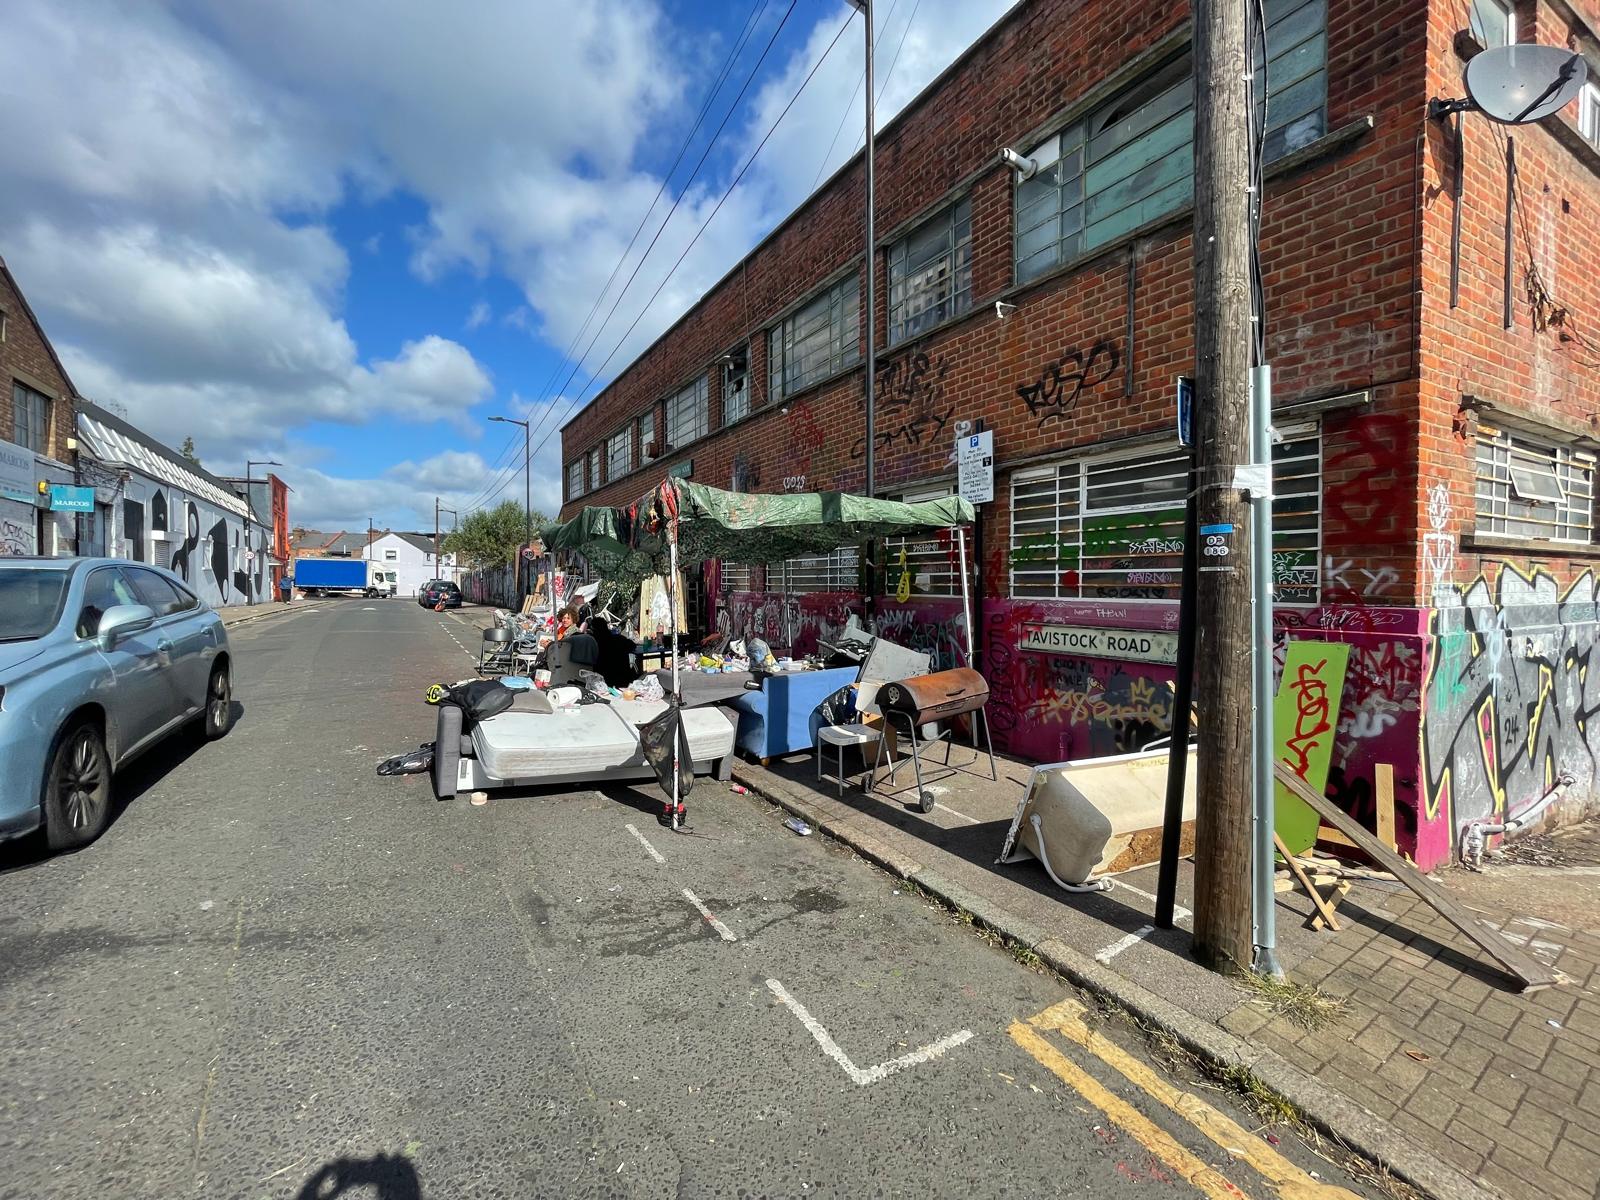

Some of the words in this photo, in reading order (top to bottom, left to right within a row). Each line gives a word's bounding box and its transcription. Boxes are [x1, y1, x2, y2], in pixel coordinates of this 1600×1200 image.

[1204, 546, 1228, 555] 186
[1026, 631, 1098, 648] TAVISTOCK
[1107, 637, 1151, 653] ROAD
